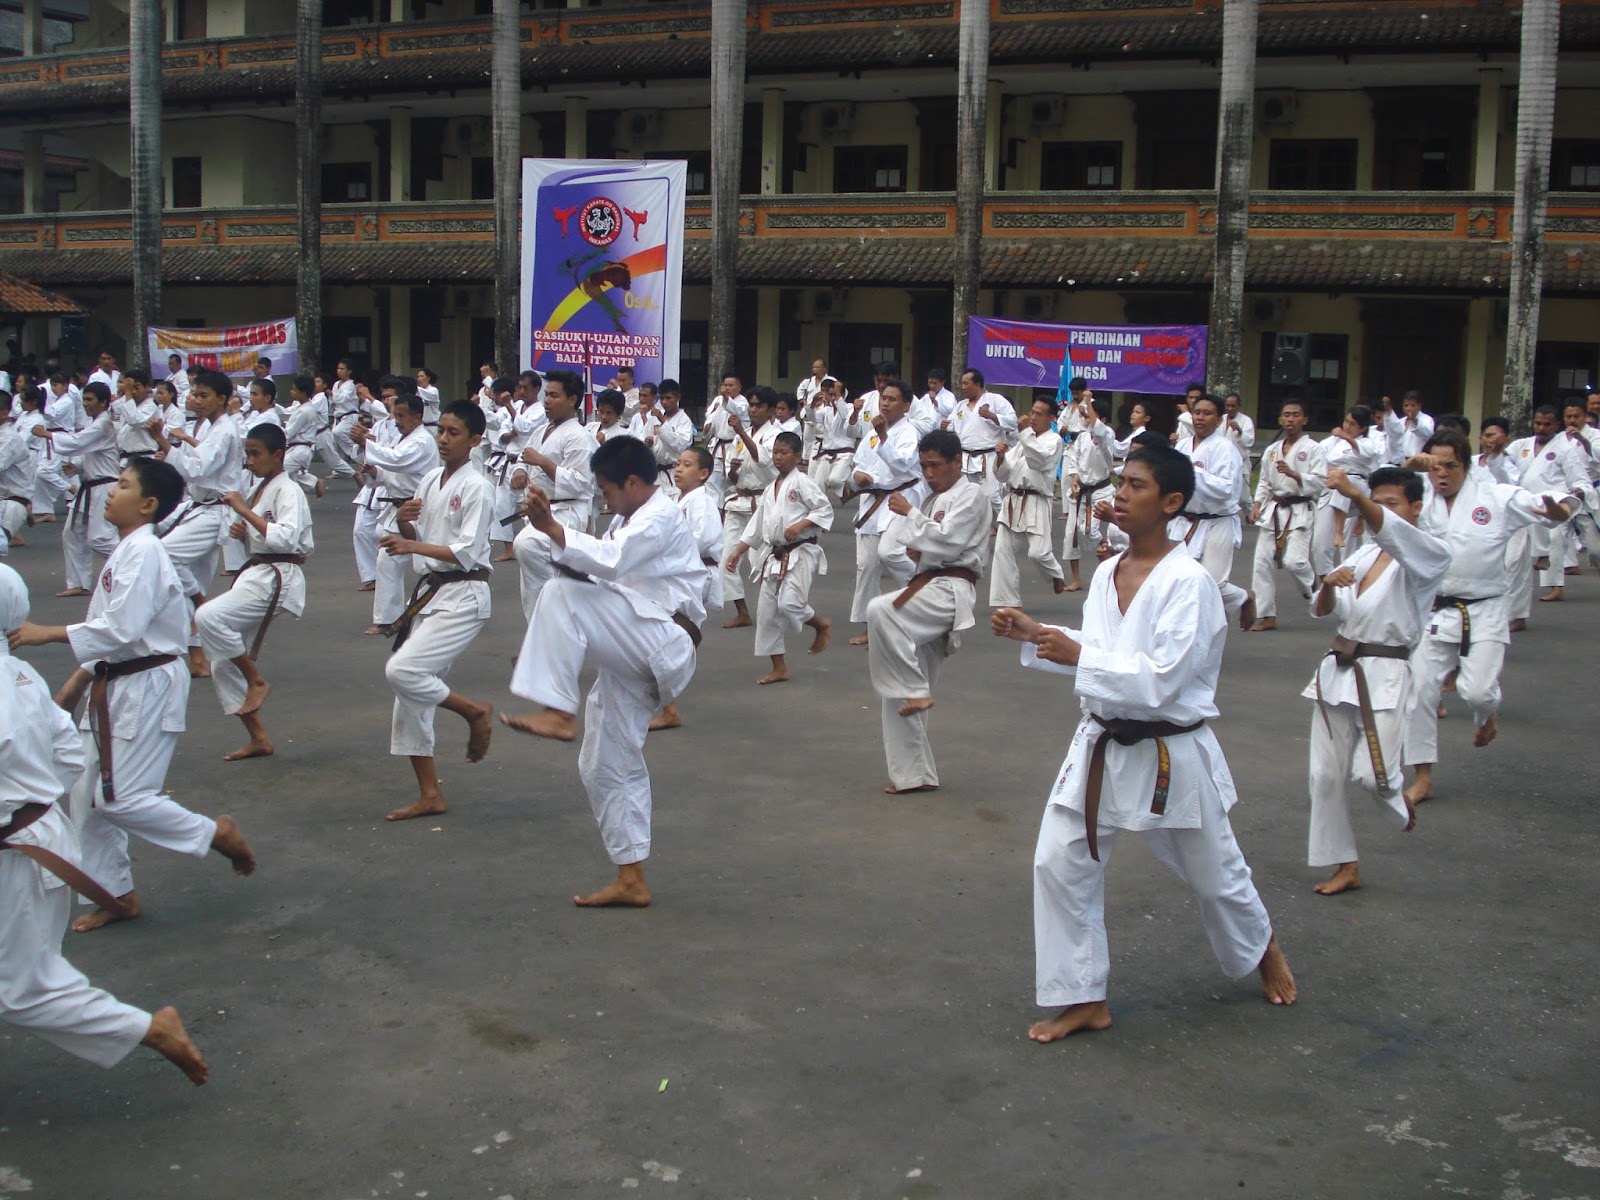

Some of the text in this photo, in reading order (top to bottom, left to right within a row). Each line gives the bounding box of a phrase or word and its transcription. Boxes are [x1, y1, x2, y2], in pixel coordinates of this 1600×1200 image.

[224, 323, 287, 347] INKANAS
[533, 330, 660, 346] GASHUKU-UJIAN DAN
[1070, 331, 1140, 346] PEMBINAAN
[534, 341, 659, 357] KEGIATAN NASIONAL
[986, 344, 1025, 359] UNTUK
[1027, 346, 1095, 362] PERSAUAN
[1097, 349, 1122, 363] DAN
